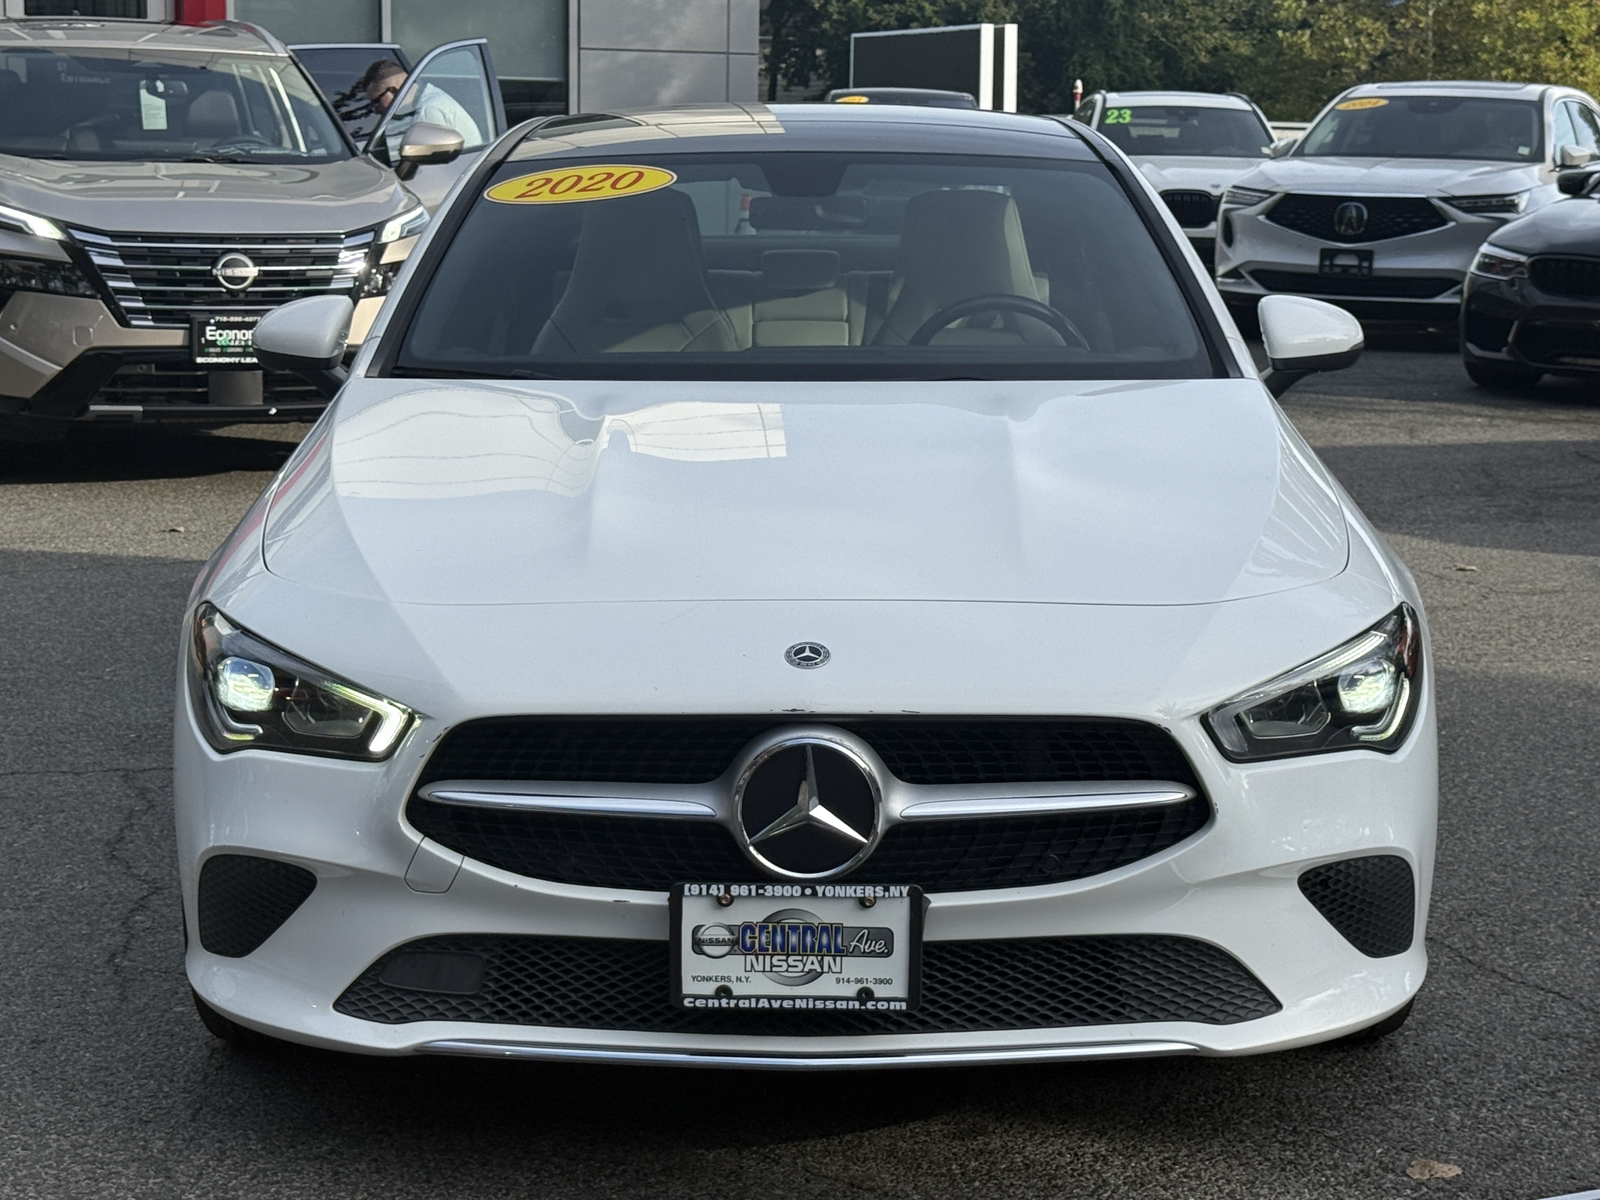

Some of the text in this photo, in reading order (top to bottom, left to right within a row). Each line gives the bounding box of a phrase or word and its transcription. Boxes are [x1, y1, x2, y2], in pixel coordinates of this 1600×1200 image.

[1105, 109, 1132, 124] 23
[514, 170, 645, 199] 2020
[730, 885, 801, 896] 961-3900
[699, 936, 734, 944] NISSAN
[738, 922, 846, 955] CENTRAL
[744, 955, 843, 973] NISSAN
[691, 975, 751, 984] YONKERS, N.Y.
[835, 977, 893, 985] 914-961-3900
[683, 998, 907, 1010] CentralAveNissan.com
